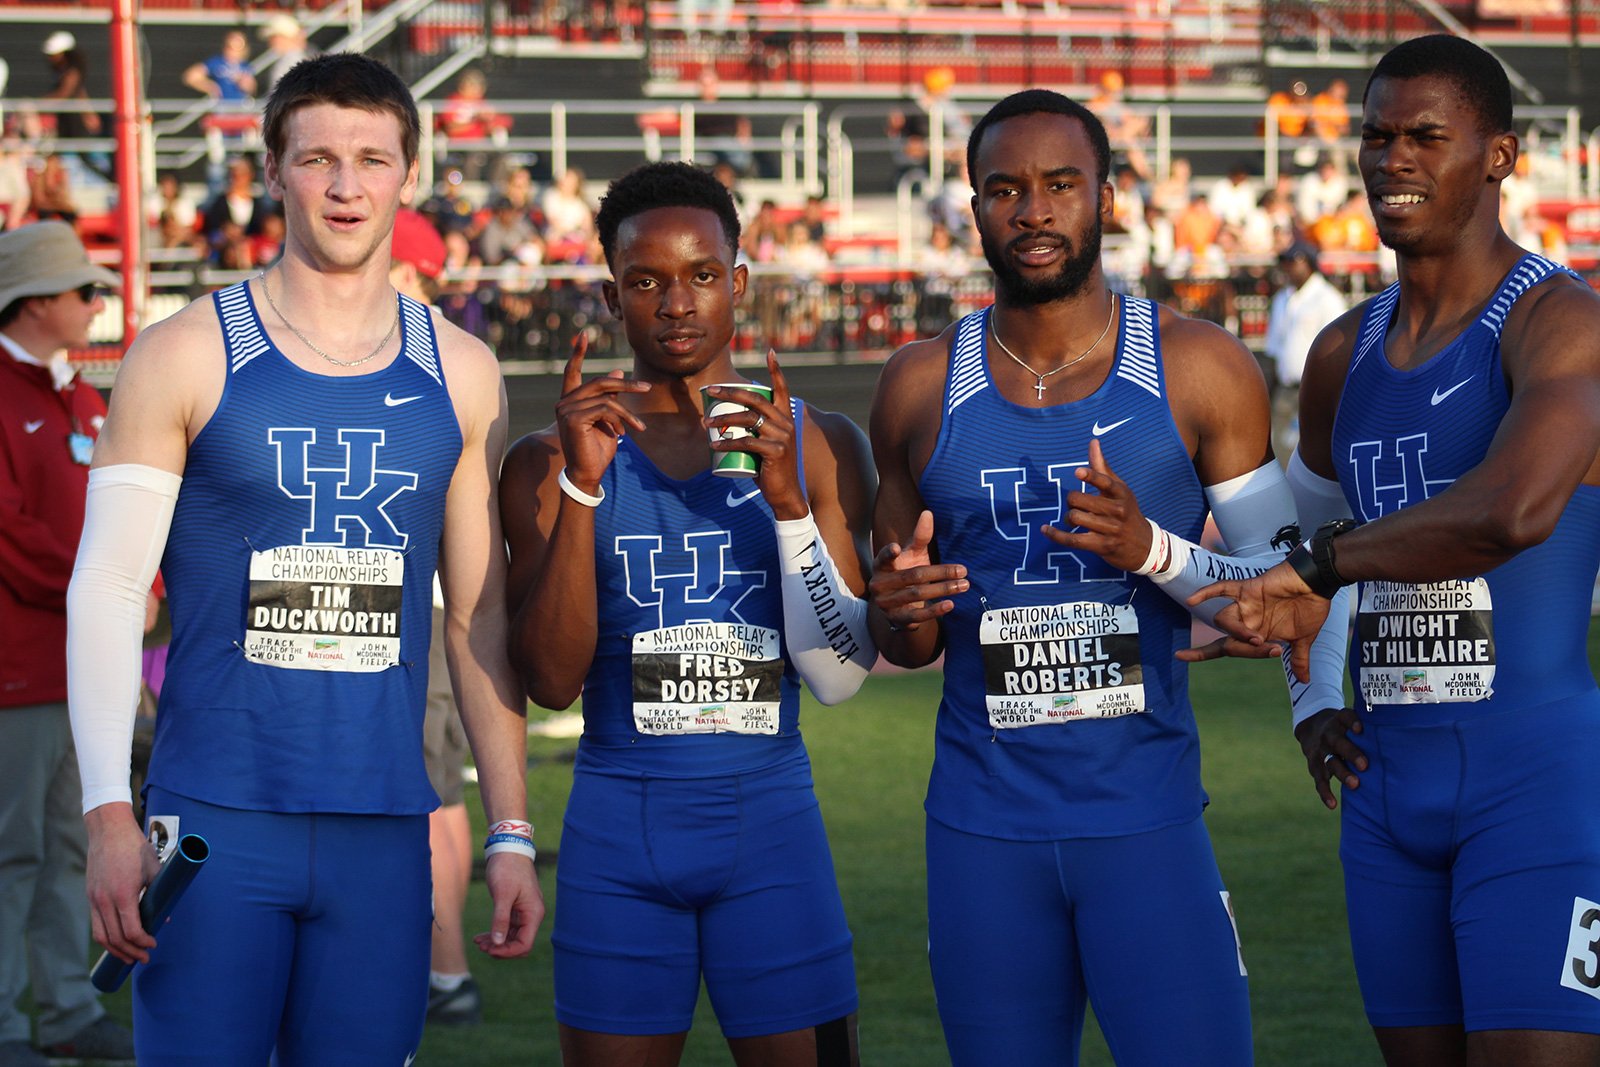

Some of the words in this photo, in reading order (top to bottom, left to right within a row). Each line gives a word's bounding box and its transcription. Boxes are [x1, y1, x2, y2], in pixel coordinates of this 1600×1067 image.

[268, 428, 418, 550] UK
[273, 548, 342, 565] NATIONAL
[348, 551, 388, 566] RELAY
[272, 564, 388, 583] CHAMPIONSHIPS
[310, 586, 350, 608] TIM
[1373, 592, 1473, 610] CHAMPIONSHIPS
[800, 561, 860, 665] KENTUCKY
[1001, 607, 1069, 625] NATIONAL
[1073, 603, 1117, 619] RELAY
[254, 606, 396, 634] DUCKWORTH
[1000, 618, 1120, 641] CHAMPIONSHIPS
[1378, 614, 1459, 638] DWIGHT
[653, 625, 722, 646] NATIONAL
[727, 625, 766, 643] RELAY
[260, 637, 295, 647] TRACK
[361, 643, 388, 651] JOHN
[250, 644, 277, 652] CAPITAL
[1013, 637, 1110, 668] DANIEL
[1362, 641, 1380, 664] ST
[1386, 639, 1489, 664] HILLAIRE
[257, 652, 295, 661] WORLD
[307, 651, 345, 660] NATIONAL
[360, 657, 388, 665] FIELD
[679, 654, 745, 677] FRED
[1004, 662, 1123, 695] ROBERTS
[1367, 674, 1390, 682] TRACK
[1450, 672, 1480, 681] JOHN
[1445, 680, 1485, 688] MCDONNELL
[661, 678, 761, 702] DORSEY
[1450, 688, 1482, 696] FIELD
[1101, 692, 1130, 702] JOHN
[1000, 700, 1034, 709] TRACK
[1096, 699, 1136, 710] MCDONNELL
[648, 709, 681, 717] TRACK
[1047, 708, 1086, 718] NATIONAL
[1101, 706, 1132, 717] FIELD
[1000, 714, 1036, 723] WORLD
[647, 722, 683, 730] WORLD
